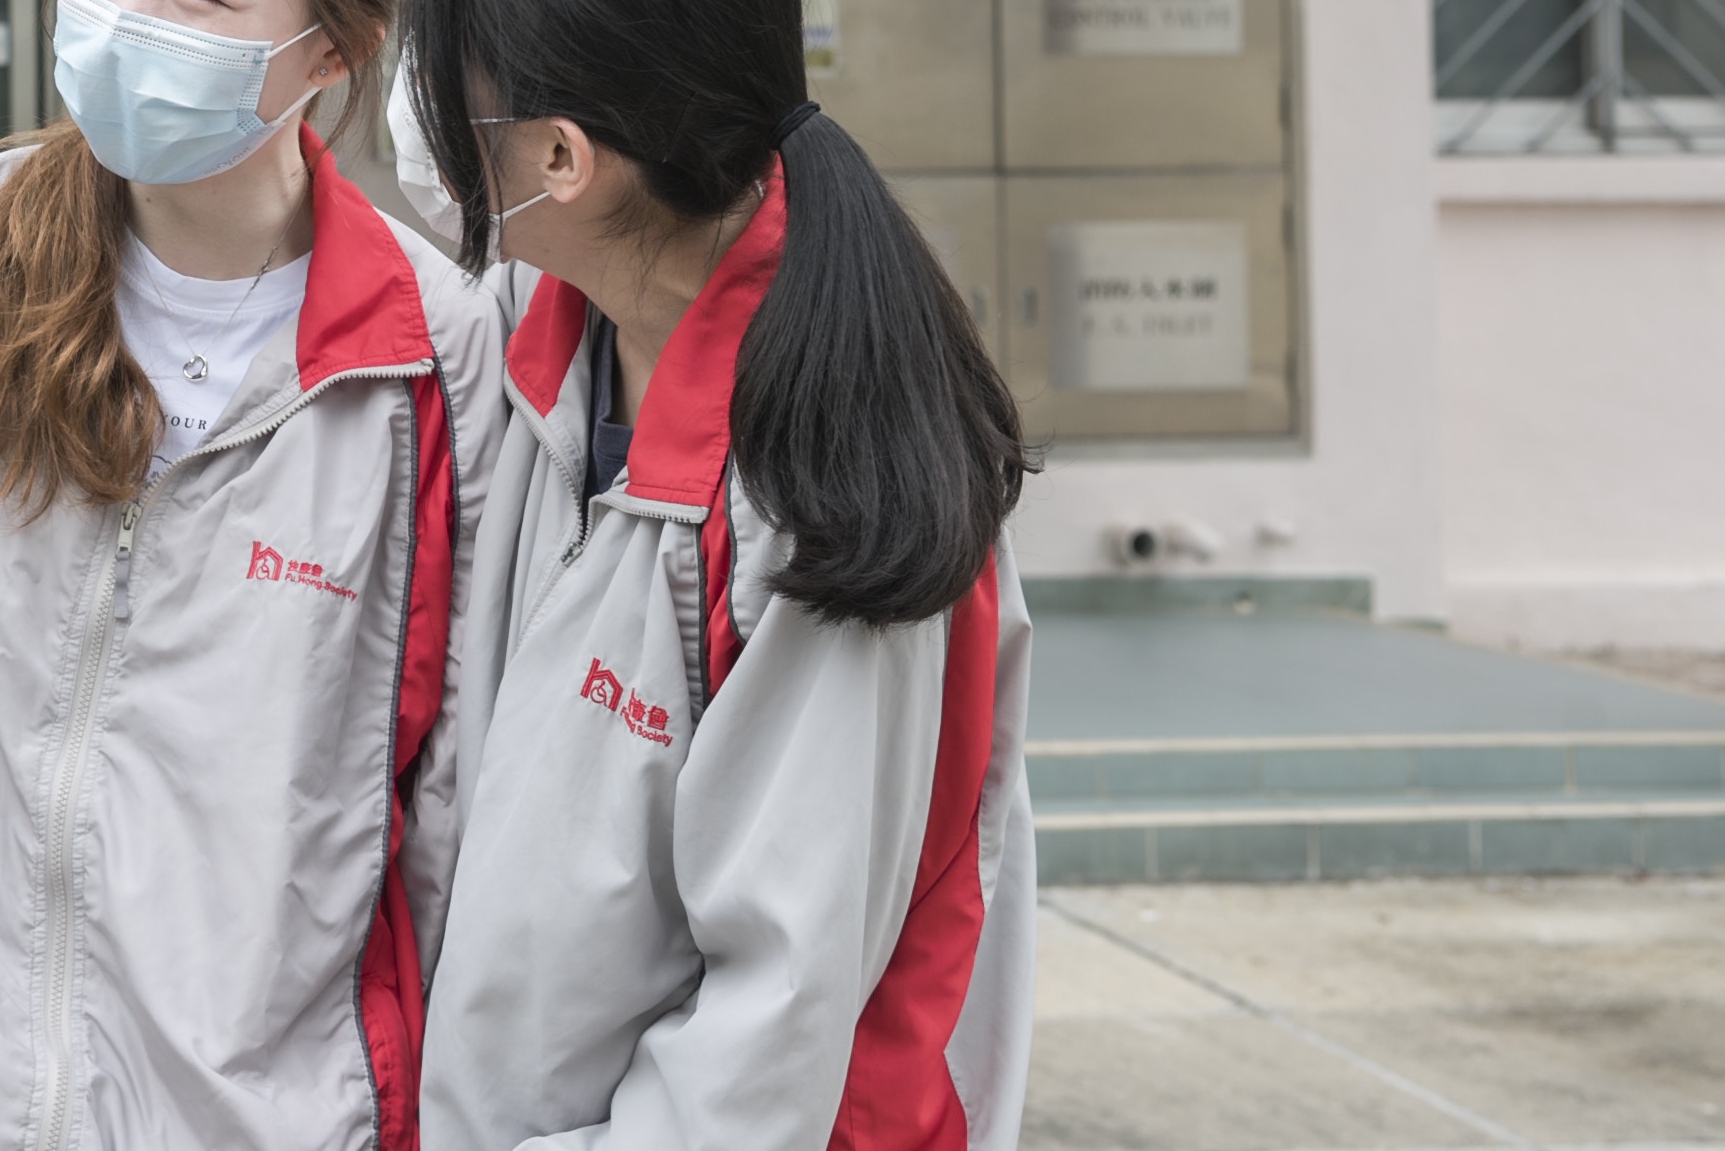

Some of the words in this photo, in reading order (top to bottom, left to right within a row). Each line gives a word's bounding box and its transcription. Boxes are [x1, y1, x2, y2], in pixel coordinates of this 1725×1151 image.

[165, 414, 207, 430] OUR
[298, 574, 323, 590] Hong
[323, 581, 358, 601] Society
[636, 725, 674, 747] Society
